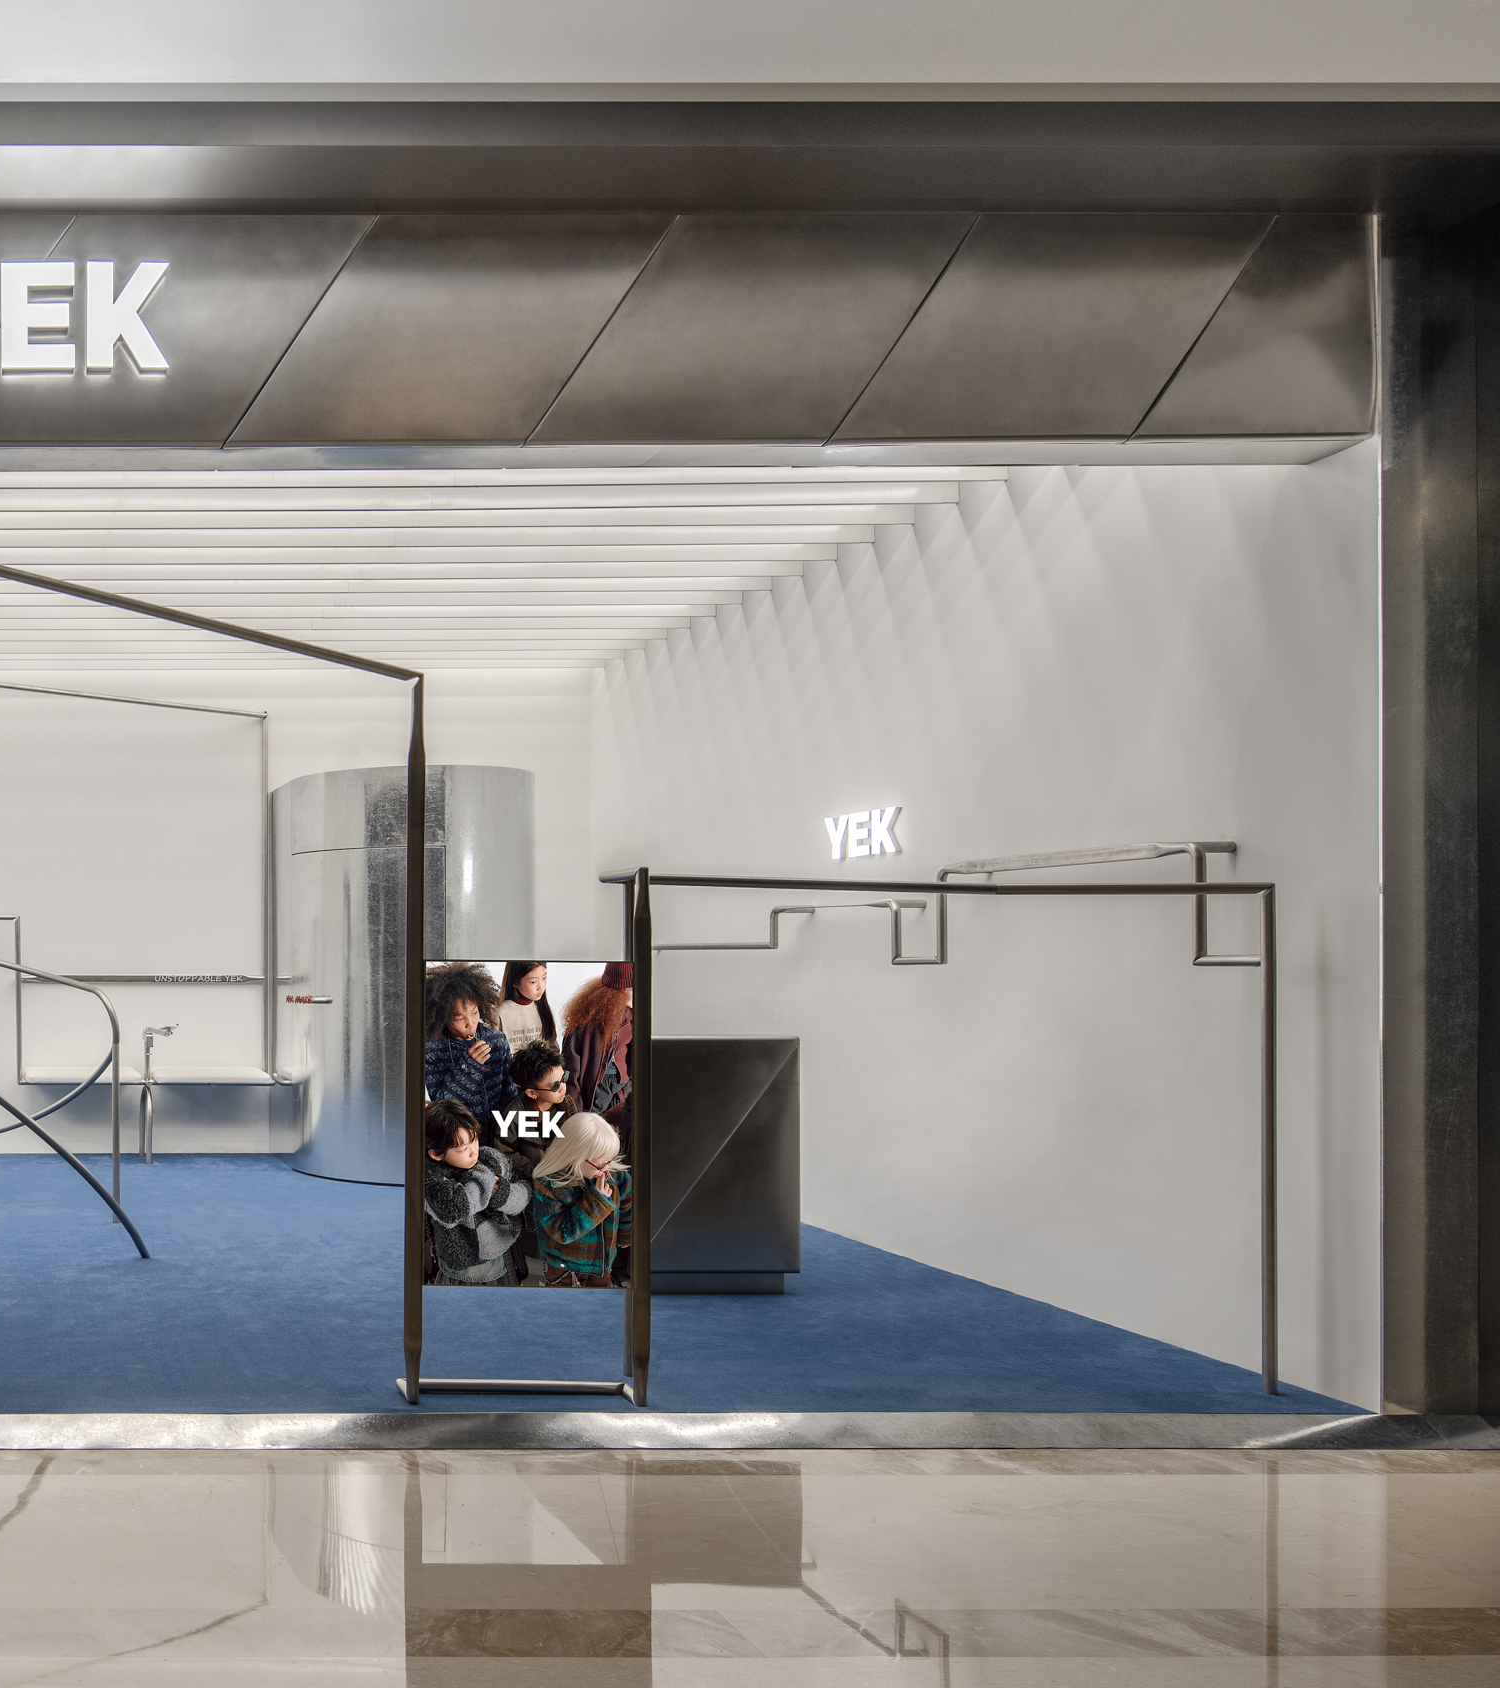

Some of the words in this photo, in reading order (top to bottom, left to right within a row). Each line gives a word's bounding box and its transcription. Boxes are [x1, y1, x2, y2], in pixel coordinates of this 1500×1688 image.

[824, 806, 902, 860] YEK
[154, 974, 222, 983] UNSTOPPABLE
[225, 974, 244, 983] YEK
[491, 1110, 566, 1139] YEK
